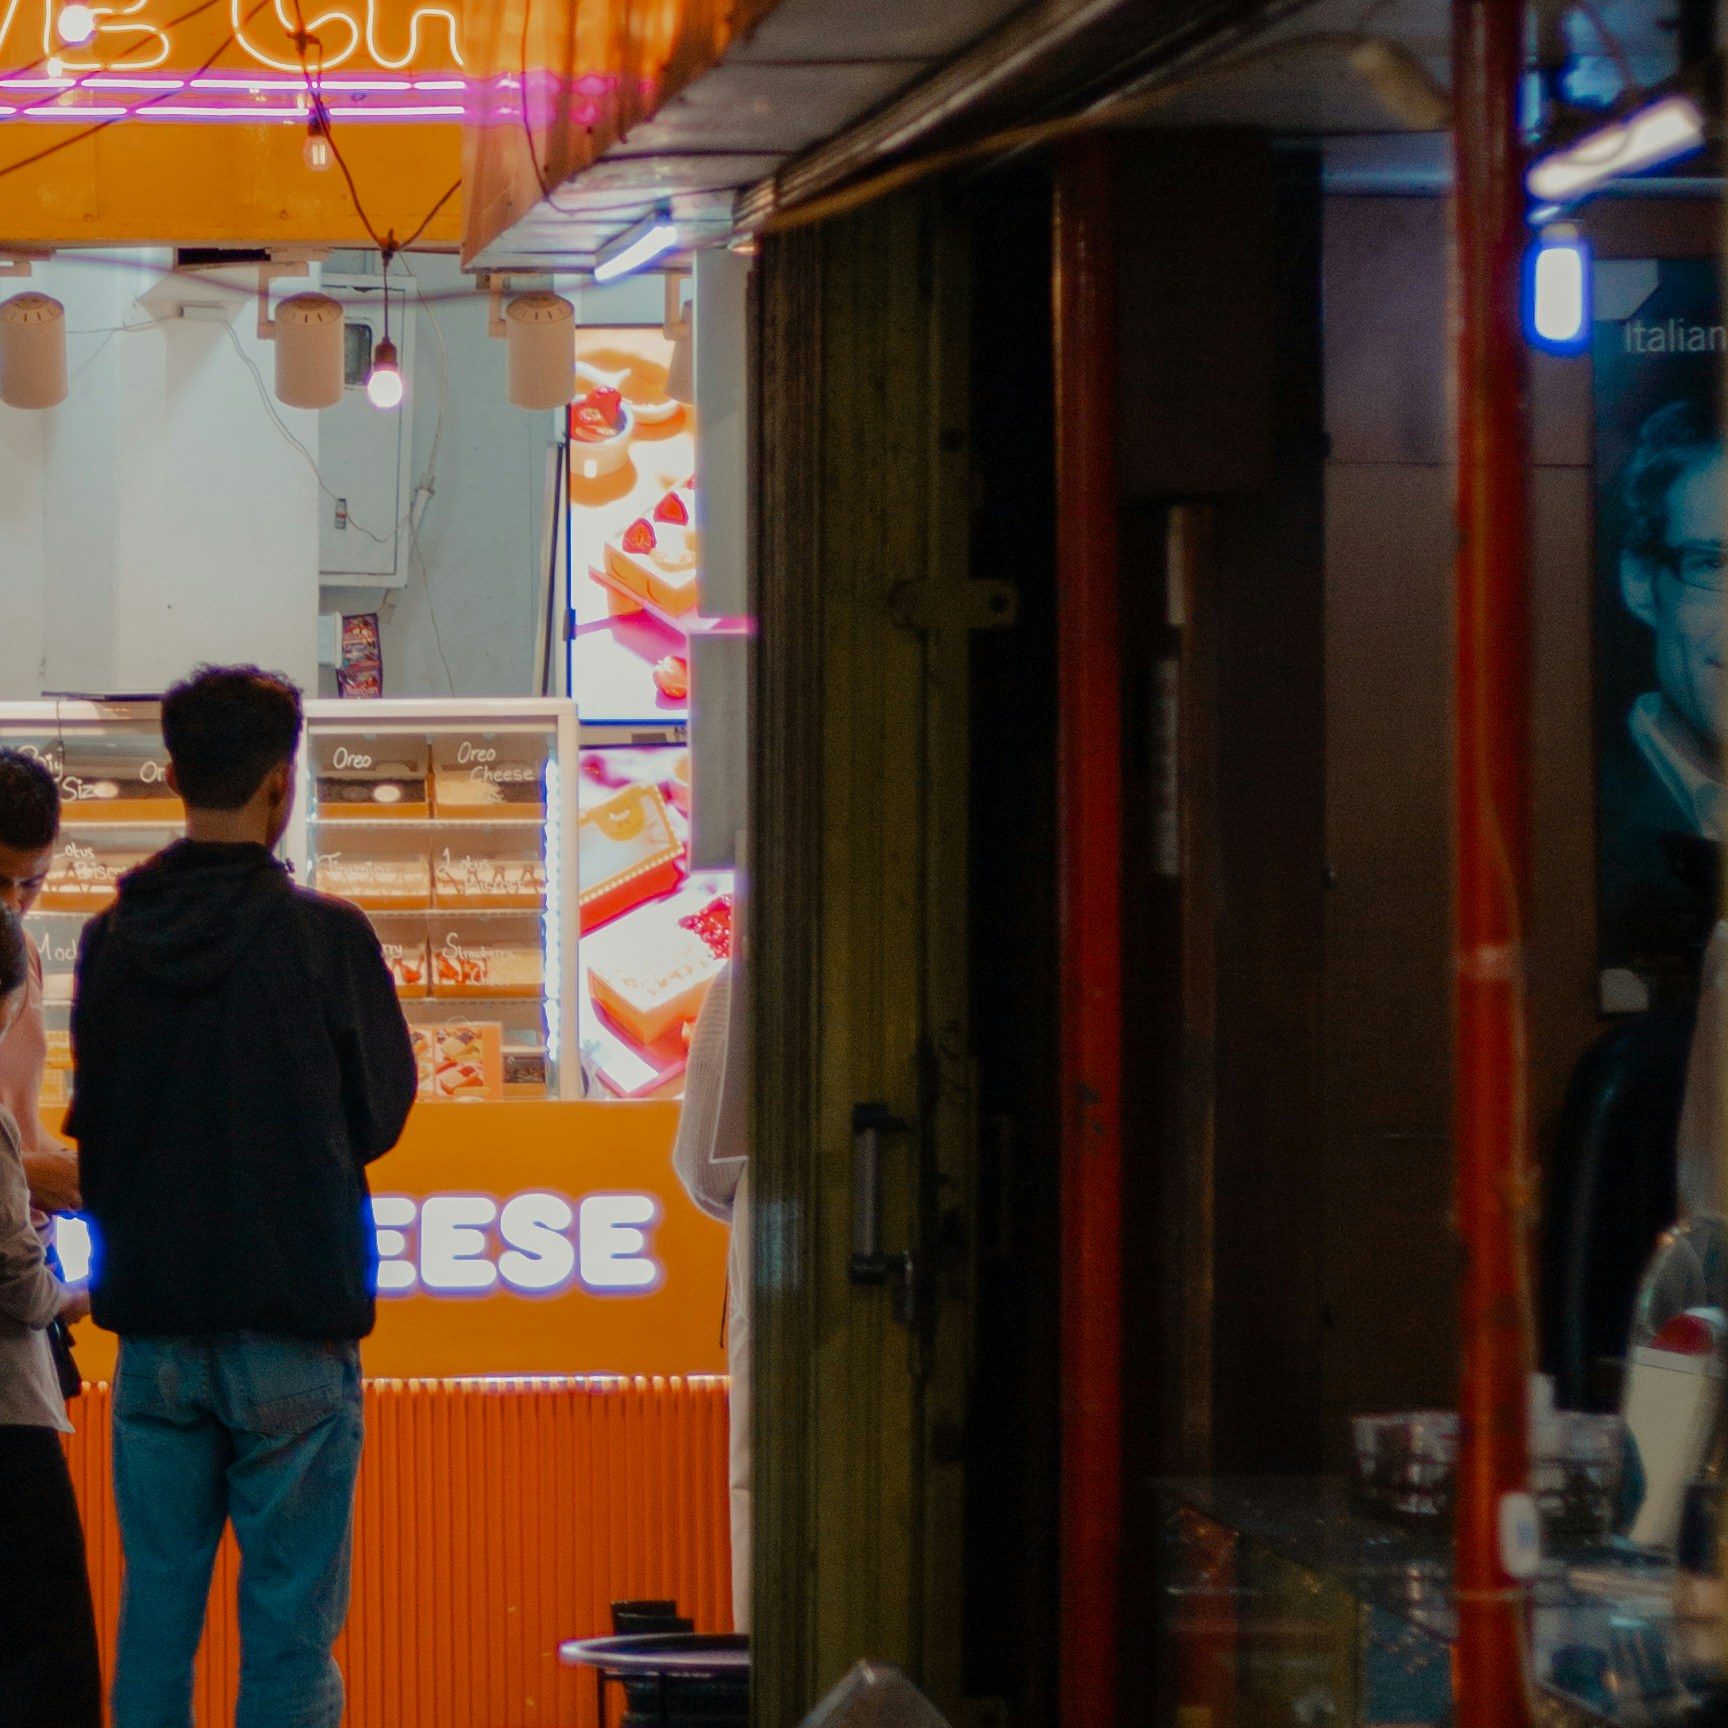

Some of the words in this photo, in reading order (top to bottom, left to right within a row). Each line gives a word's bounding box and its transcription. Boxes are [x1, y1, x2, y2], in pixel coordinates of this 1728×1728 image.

[1624, 318, 1727, 353] Italian
[333, 747, 372, 769] Oreo
[457, 741, 497, 764] Oreo
[471, 765, 536, 782] Cheese
